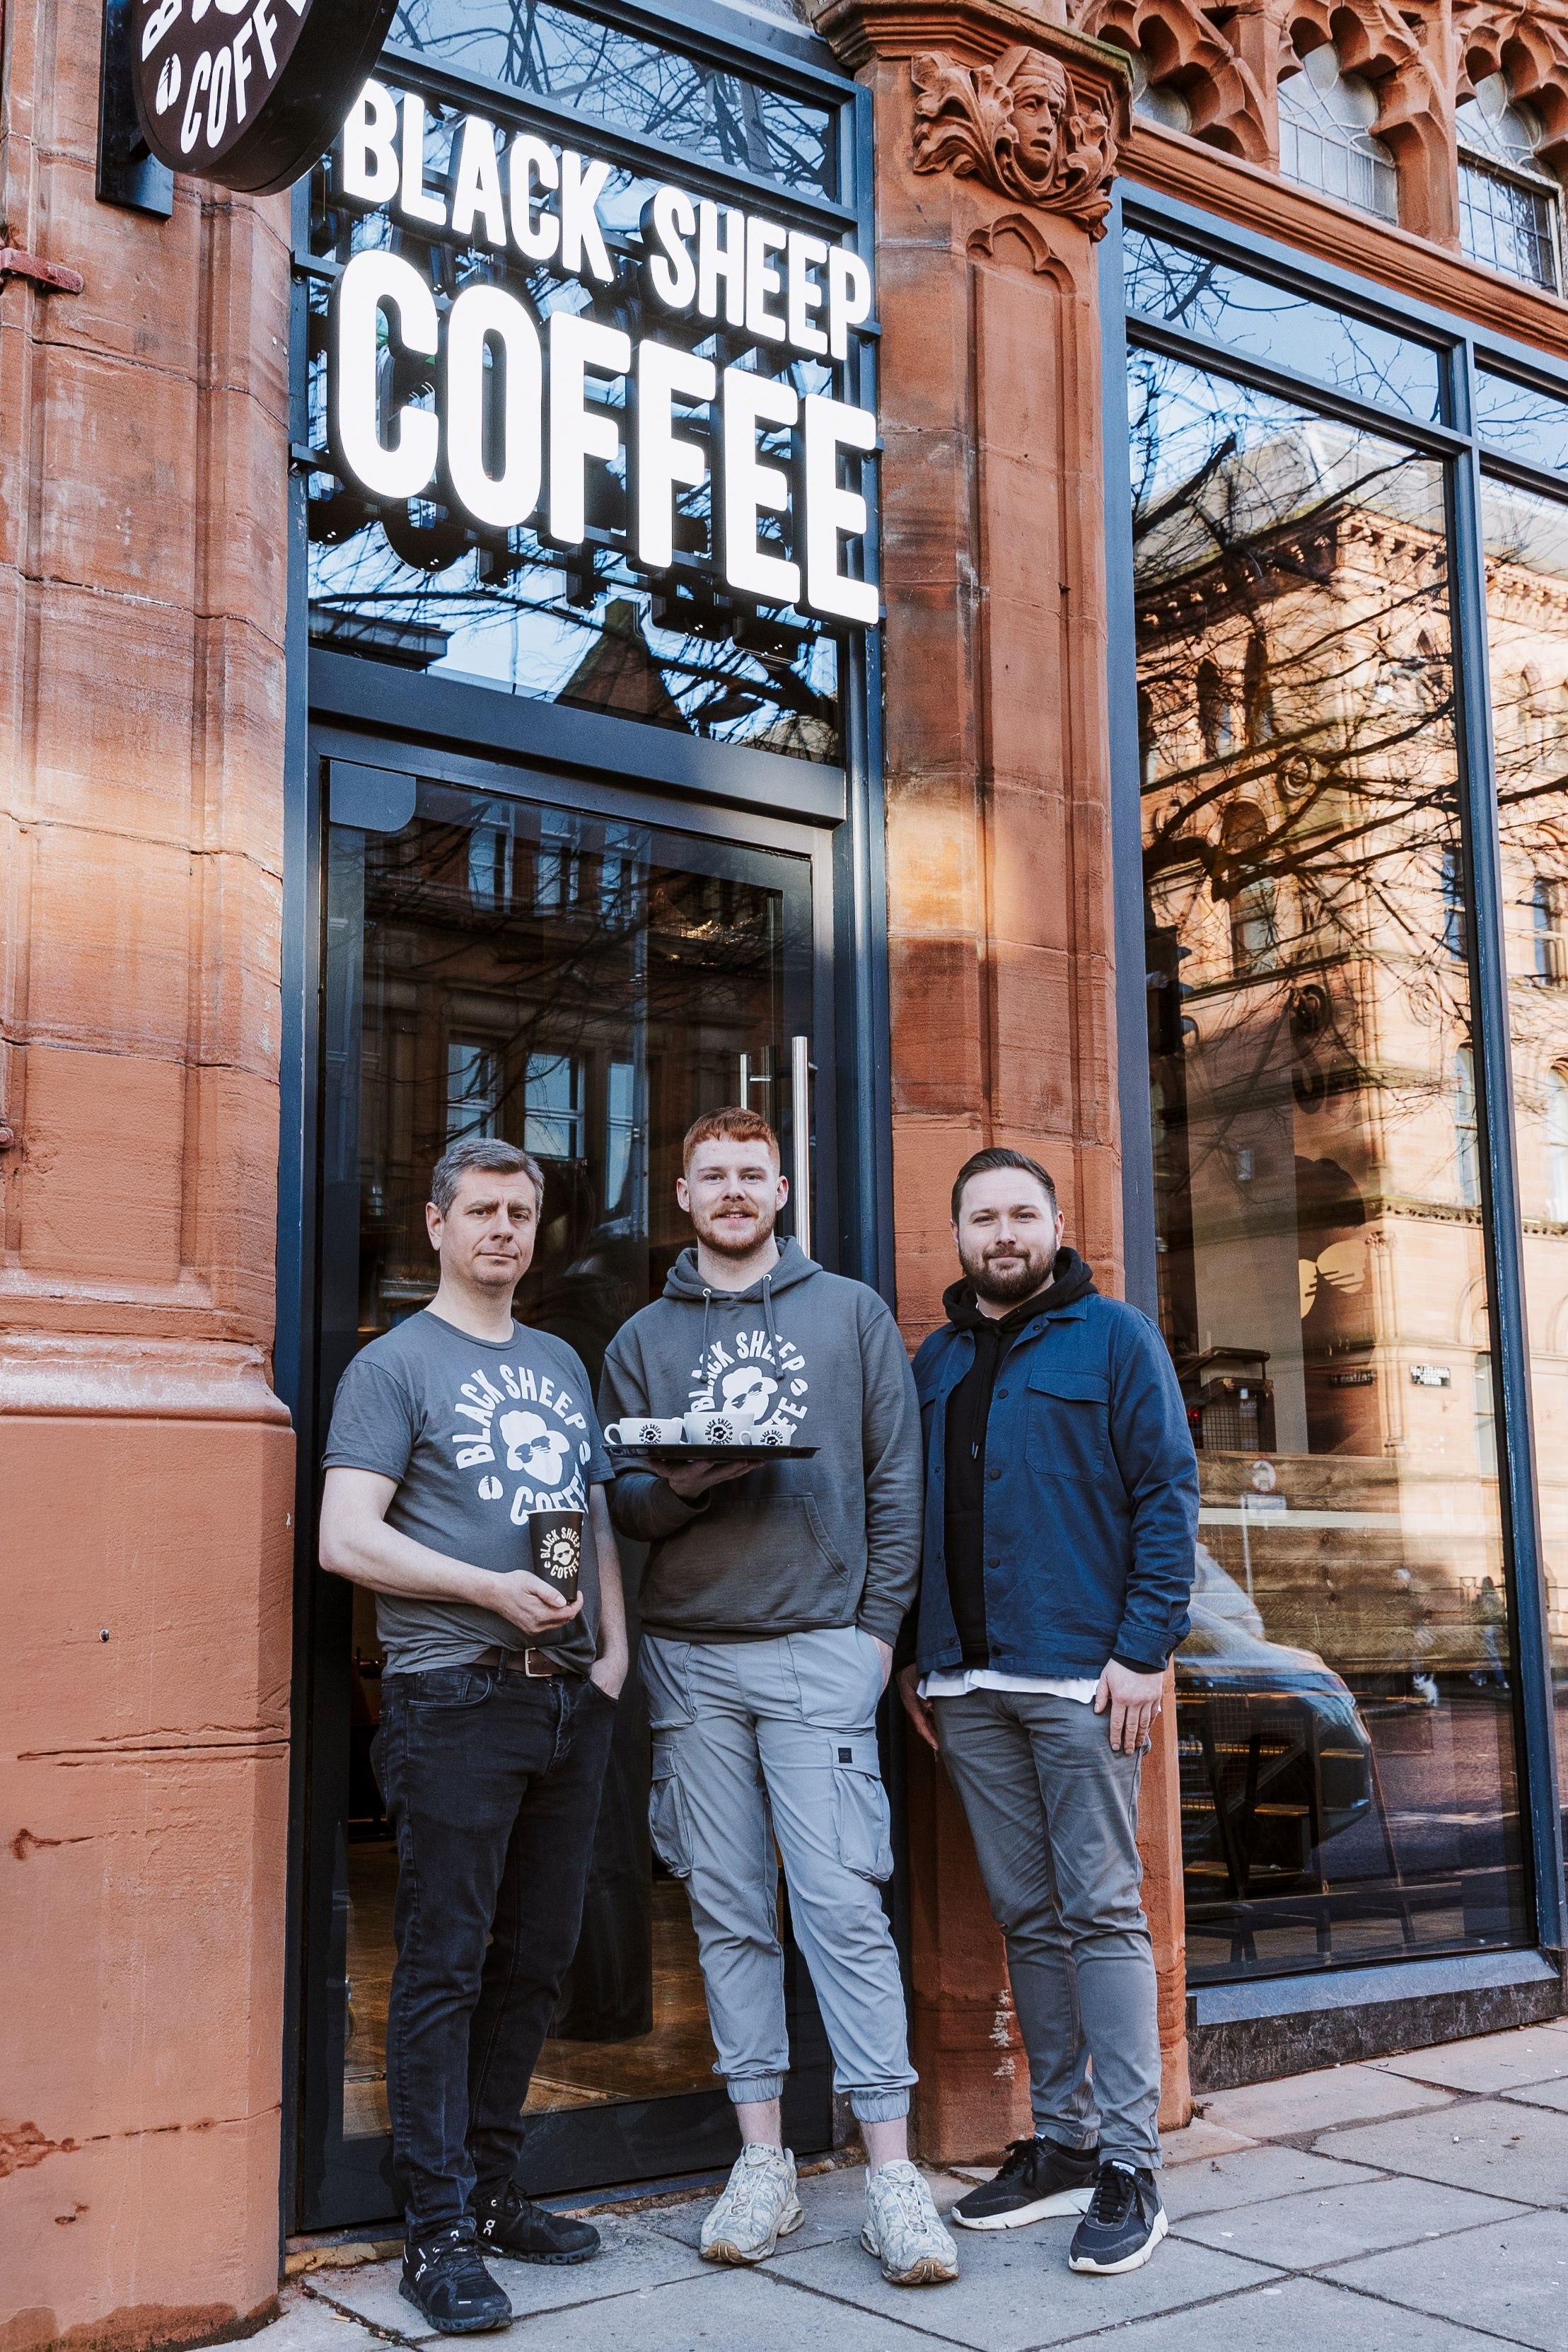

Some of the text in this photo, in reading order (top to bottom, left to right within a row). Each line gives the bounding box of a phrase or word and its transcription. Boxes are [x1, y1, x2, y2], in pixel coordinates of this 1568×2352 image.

[343, 77, 872, 361] BLACK SHEEP
[338, 250, 879, 625] COFFEE
[688, 1330, 806, 1413] BLACK SHEEP
[452, 1364, 586, 1469] BLACK SHEEP
[704, 1418, 733, 1435] BLACK SHEEP
[540, 1527, 580, 1559] BLACK SHEEP
[550, 1558, 579, 1579] COFFEE
